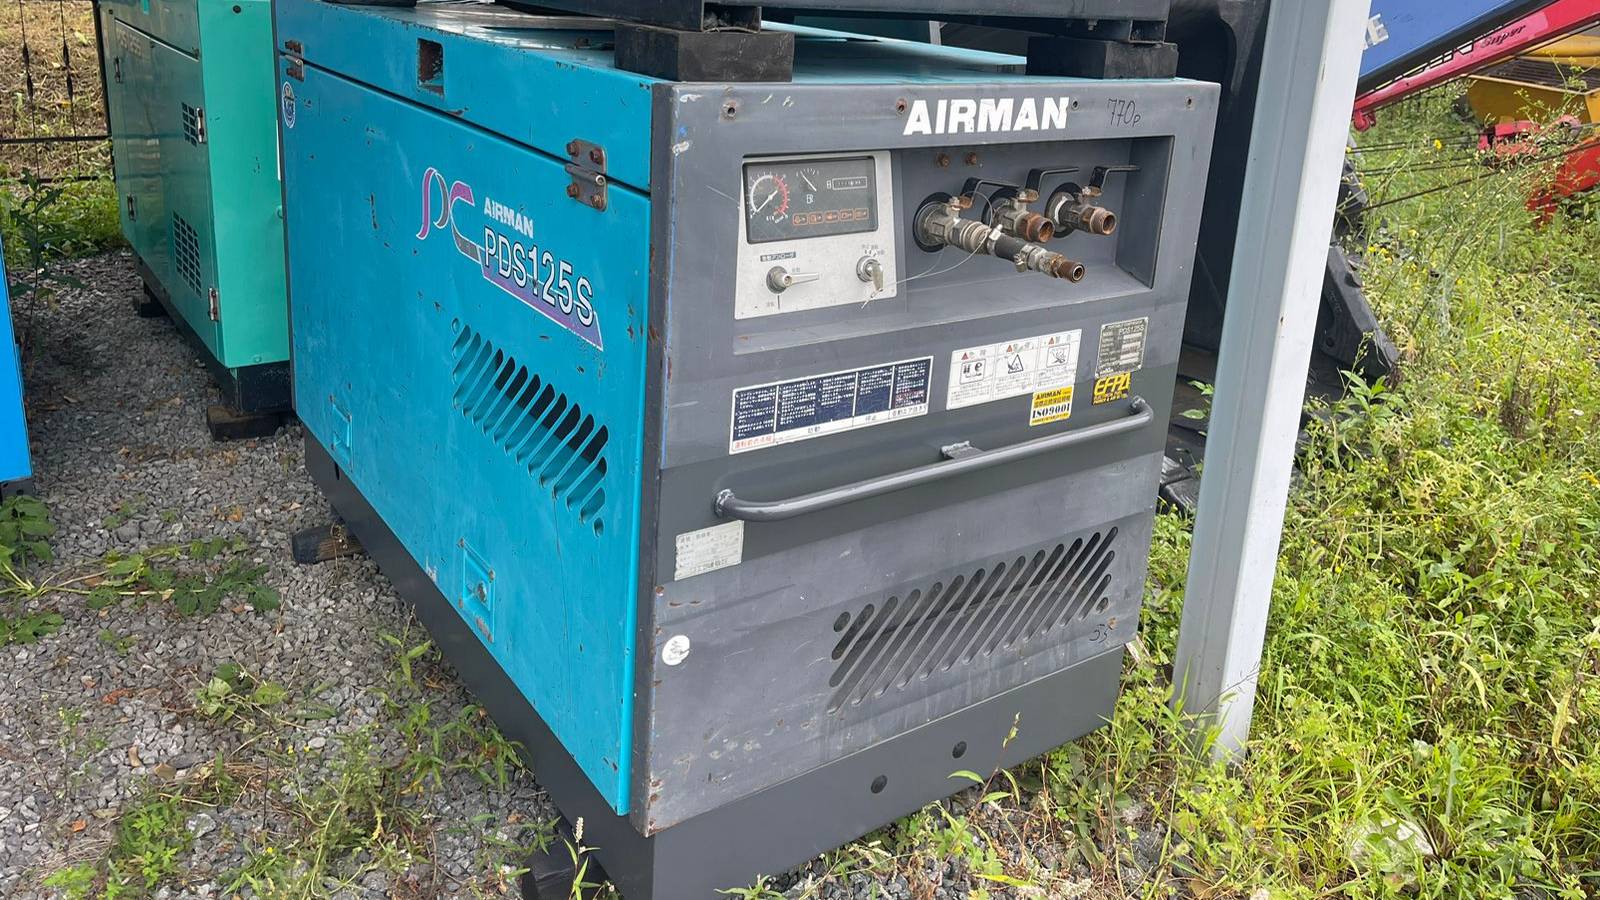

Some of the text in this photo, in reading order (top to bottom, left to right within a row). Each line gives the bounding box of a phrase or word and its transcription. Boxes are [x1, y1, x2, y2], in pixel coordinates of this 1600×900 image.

[903, 97, 1069, 136] AIRMAN
[484, 197, 535, 239] AIRMAN
[483, 225, 595, 327] PDS125S
[1033, 403, 1070, 418] ISO9001
